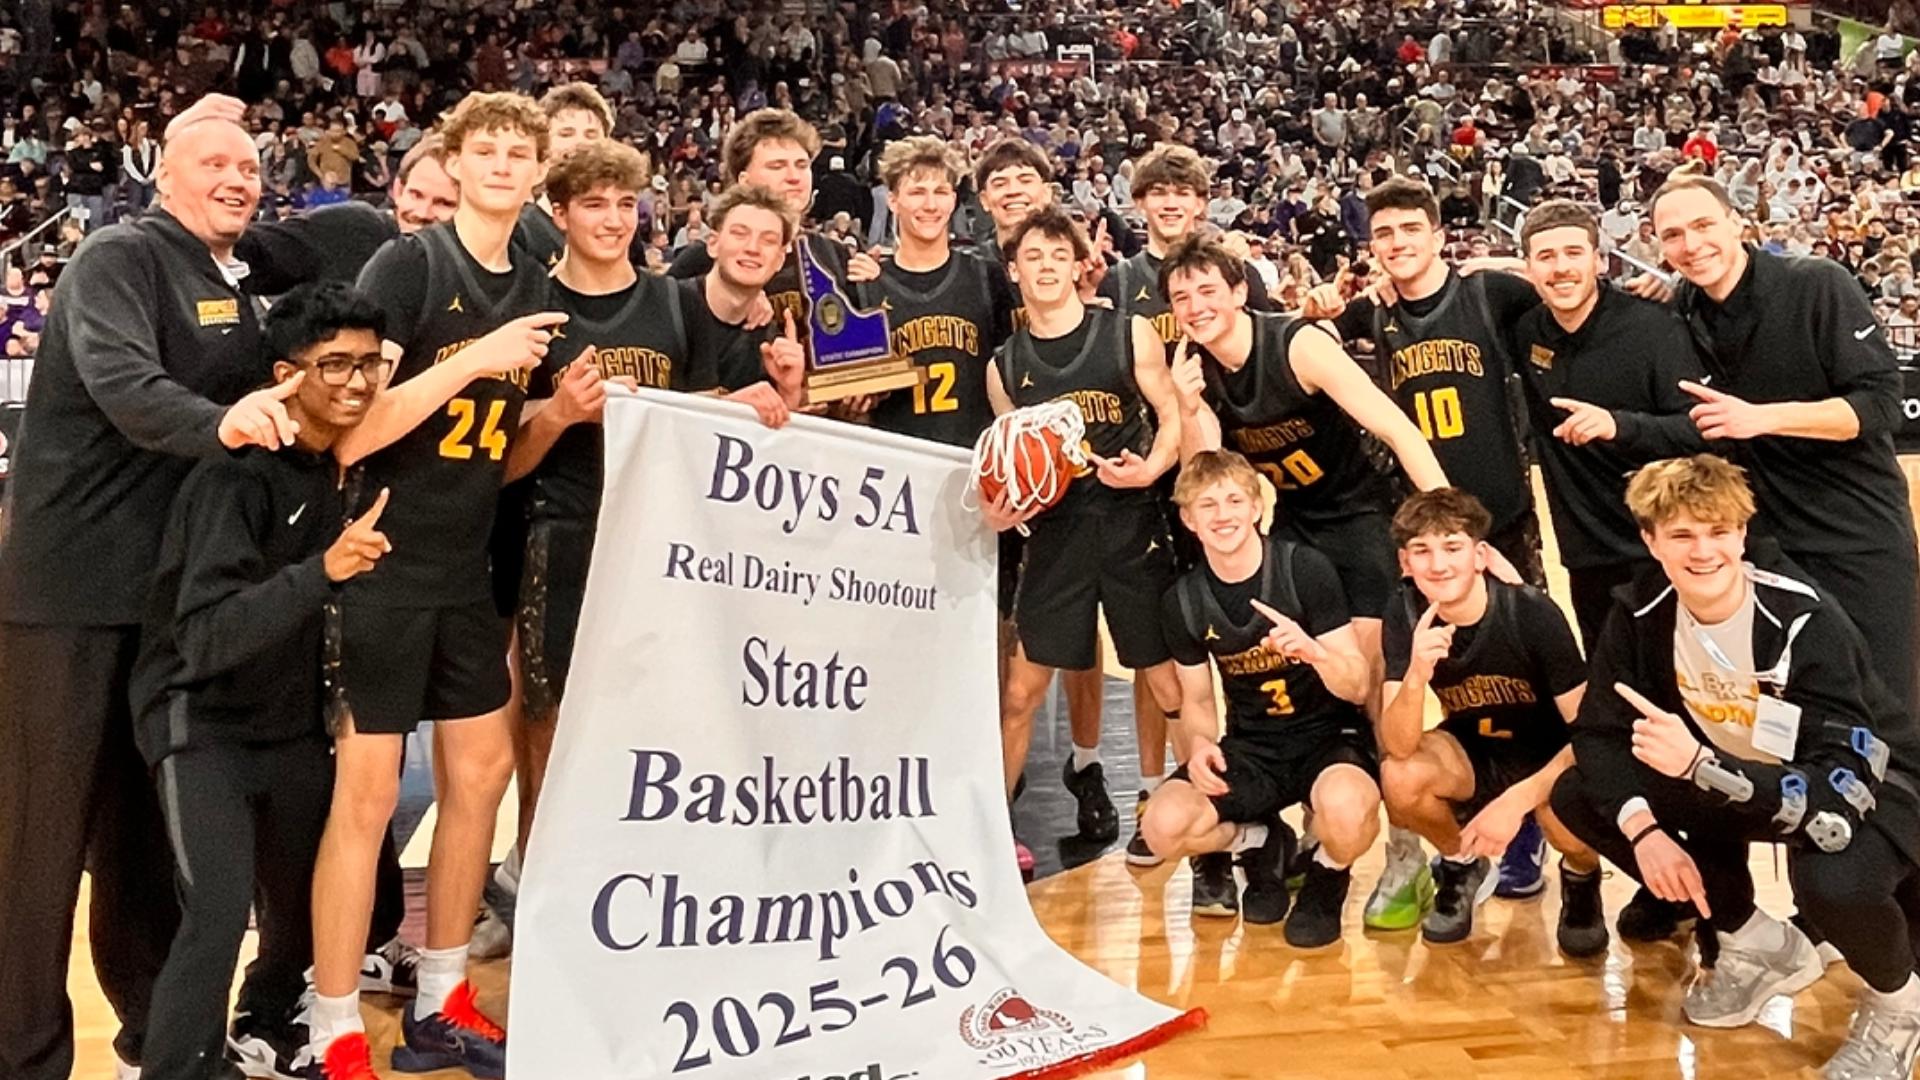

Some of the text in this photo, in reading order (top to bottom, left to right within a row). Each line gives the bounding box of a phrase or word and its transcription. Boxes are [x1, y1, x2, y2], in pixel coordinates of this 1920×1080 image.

[914, 362, 958, 414] 12
[1414, 387, 1464, 440] 10
[439, 398, 507, 460] 24
[706, 432, 921, 535] Boys 5A
[1255, 449, 1324, 489] 20
[665, 543, 937, 611] Real Dairy Shootout
[742, 636, 868, 711] State
[1260, 679, 1294, 716] 3
[619, 749, 937, 826] Basketball
[591, 859, 977, 961] Champions
[662, 925, 977, 1072] 2025-26
